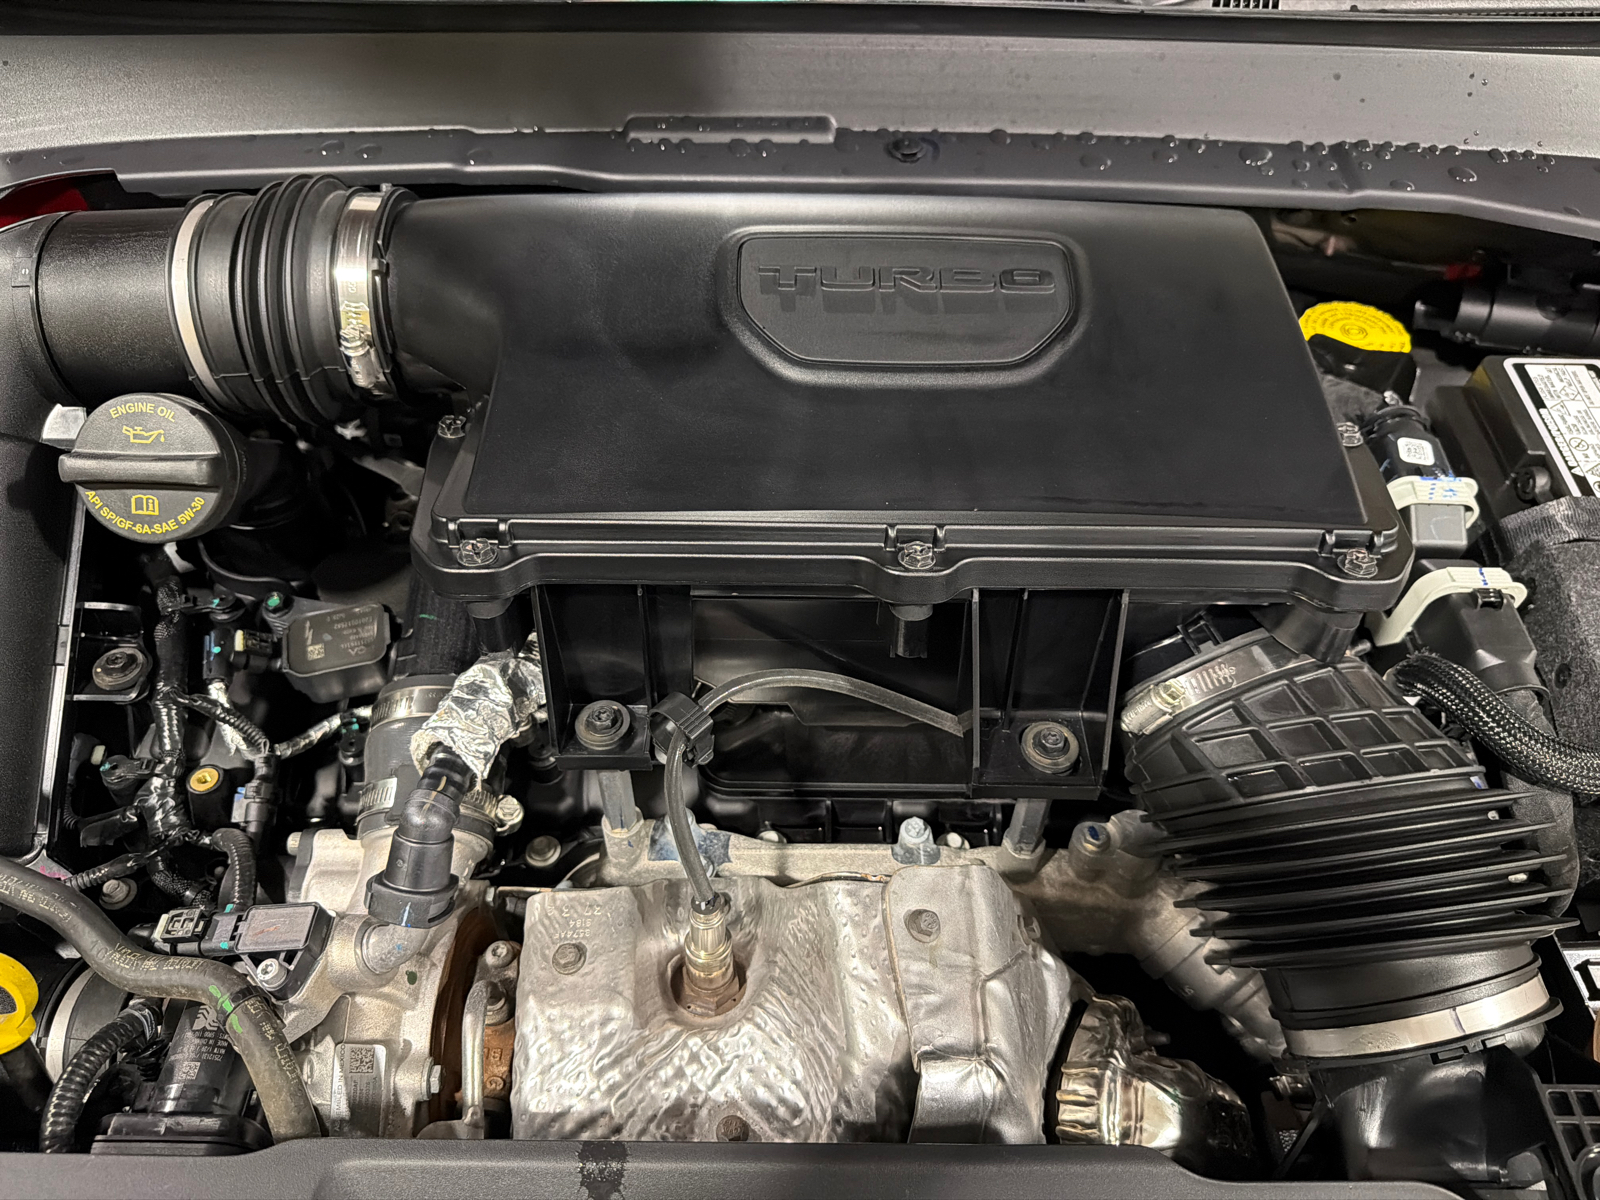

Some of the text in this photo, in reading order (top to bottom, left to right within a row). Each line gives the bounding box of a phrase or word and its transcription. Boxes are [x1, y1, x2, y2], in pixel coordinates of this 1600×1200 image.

[758, 266, 1056, 293] TURBO
[109, 402, 176, 422] ENGINE OIL
[85, 490, 205, 534] API SP/GF-6A-SAE 5W-30
